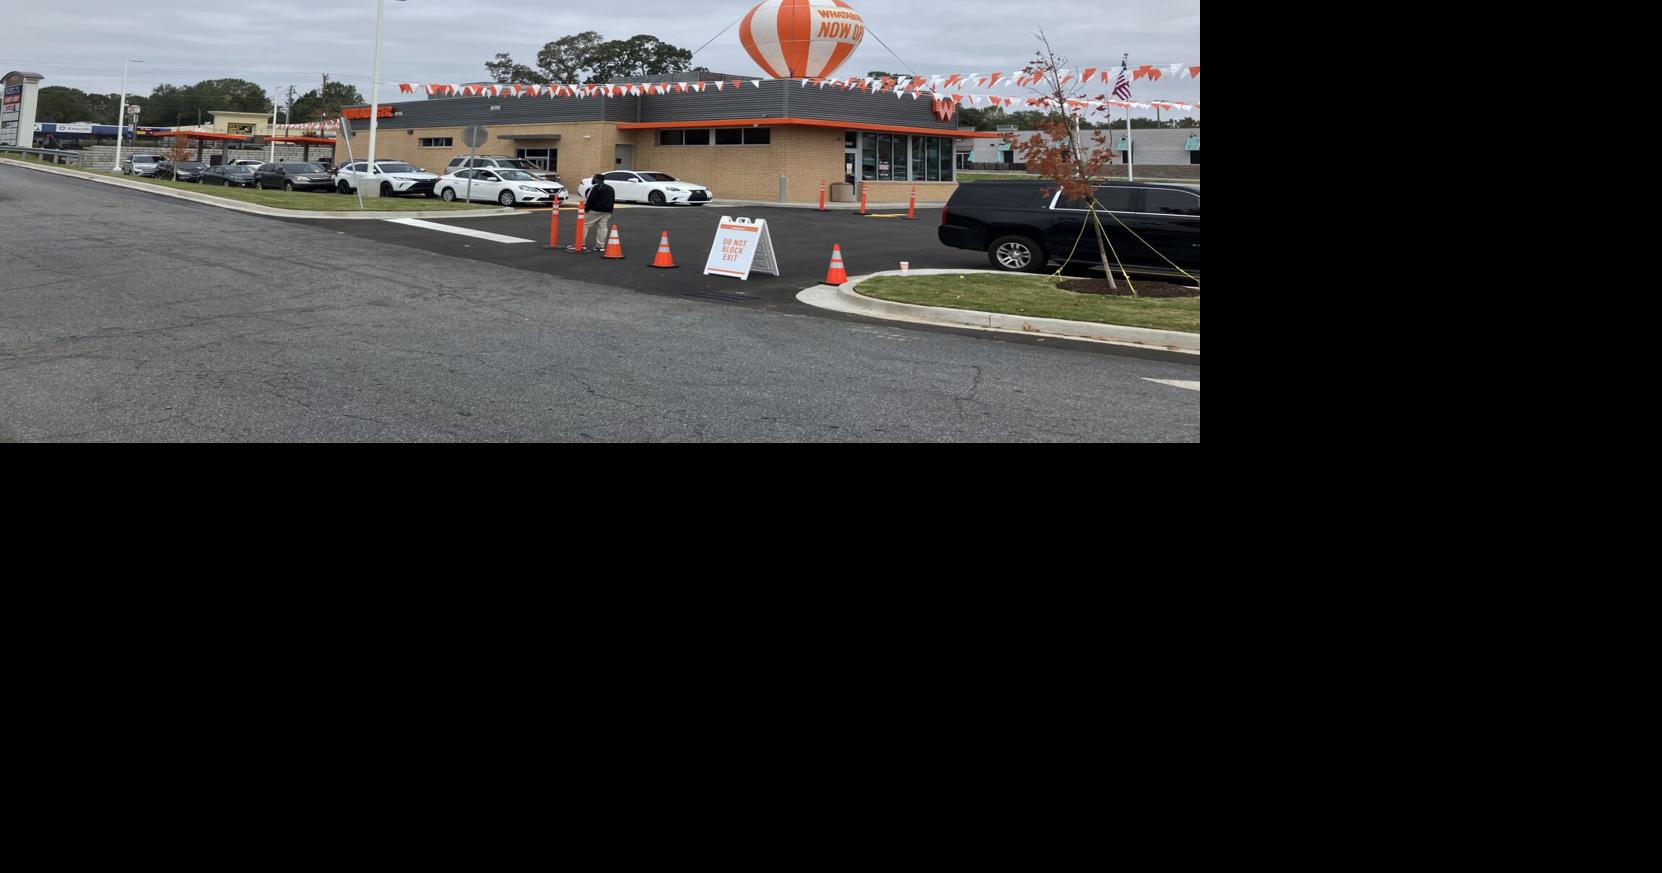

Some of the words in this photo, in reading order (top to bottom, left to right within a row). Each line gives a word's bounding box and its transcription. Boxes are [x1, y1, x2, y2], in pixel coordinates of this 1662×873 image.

[818, 22, 851, 38] NOW
[935, 100, 956, 121] W
[723, 238, 733, 246] DO
[733, 239, 748, 247] NOT
[722, 246, 744, 254] BLOCK
[722, 254, 738, 262] EXIT
